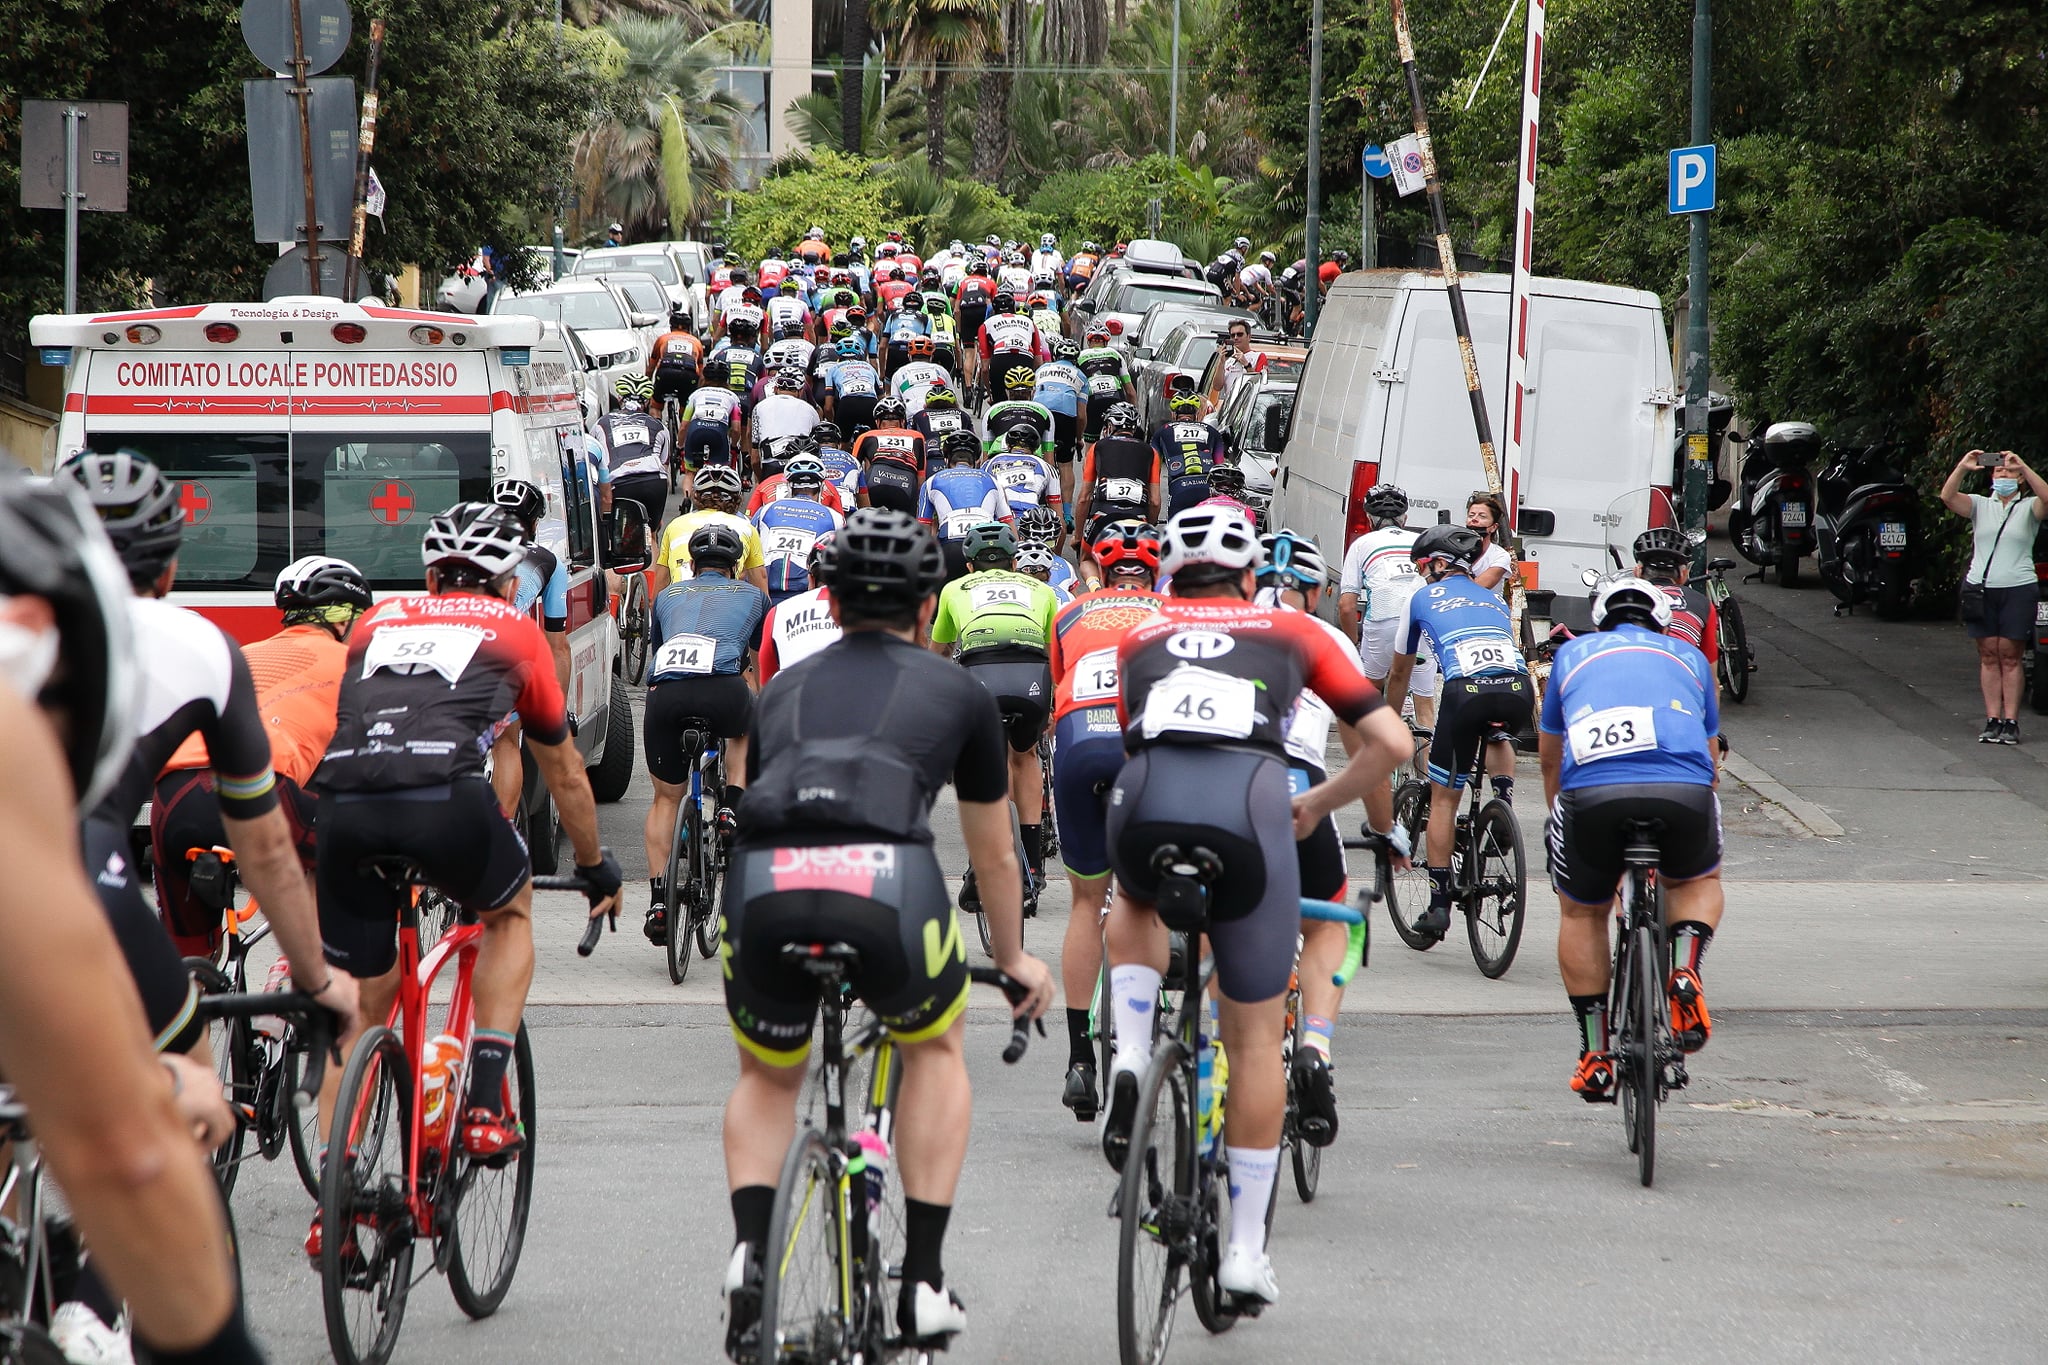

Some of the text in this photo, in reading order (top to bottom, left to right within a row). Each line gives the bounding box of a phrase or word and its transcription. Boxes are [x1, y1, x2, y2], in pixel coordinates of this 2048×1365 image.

[1677, 153, 1706, 206] P
[230, 308, 339, 320] Tecnologia & Design
[993, 318, 1030, 329] MILANO
[1010, 338, 1024, 347] 156
[117, 361, 458, 388] COMITATO LOCALE PONTEDASSIO
[914, 373, 931, 381] 135
[1039, 370, 1077, 384] BIANCHI
[850, 384, 866, 393] 232
[1096, 382, 1111, 390] 152
[704, 409, 715, 418] 14
[621, 431, 641, 441] 137
[1182, 429, 1200, 438] 217
[887, 437, 905, 447] 231
[1006, 473, 1026, 484] 120
[1118, 486, 1131, 496] 37
[1409, 498, 1439, 510] VECO
[957, 522, 972, 533] 14
[777, 537, 803, 550] 241
[986, 589, 1017, 601] 261
[1082, 596, 1164, 612] BAHRAIN
[393, 641, 437, 658] 58
[1563, 630, 1701, 677] ITALIA
[665, 648, 699, 666] 214
[1470, 648, 1505, 666] 205
[1173, 693, 1216, 721] 46
[1087, 709, 1118, 724] BAHRA
[1087, 723, 1121, 732] MERID
[1589, 719, 1635, 750] 263
[1551, 793, 1572, 880] ITALIA
